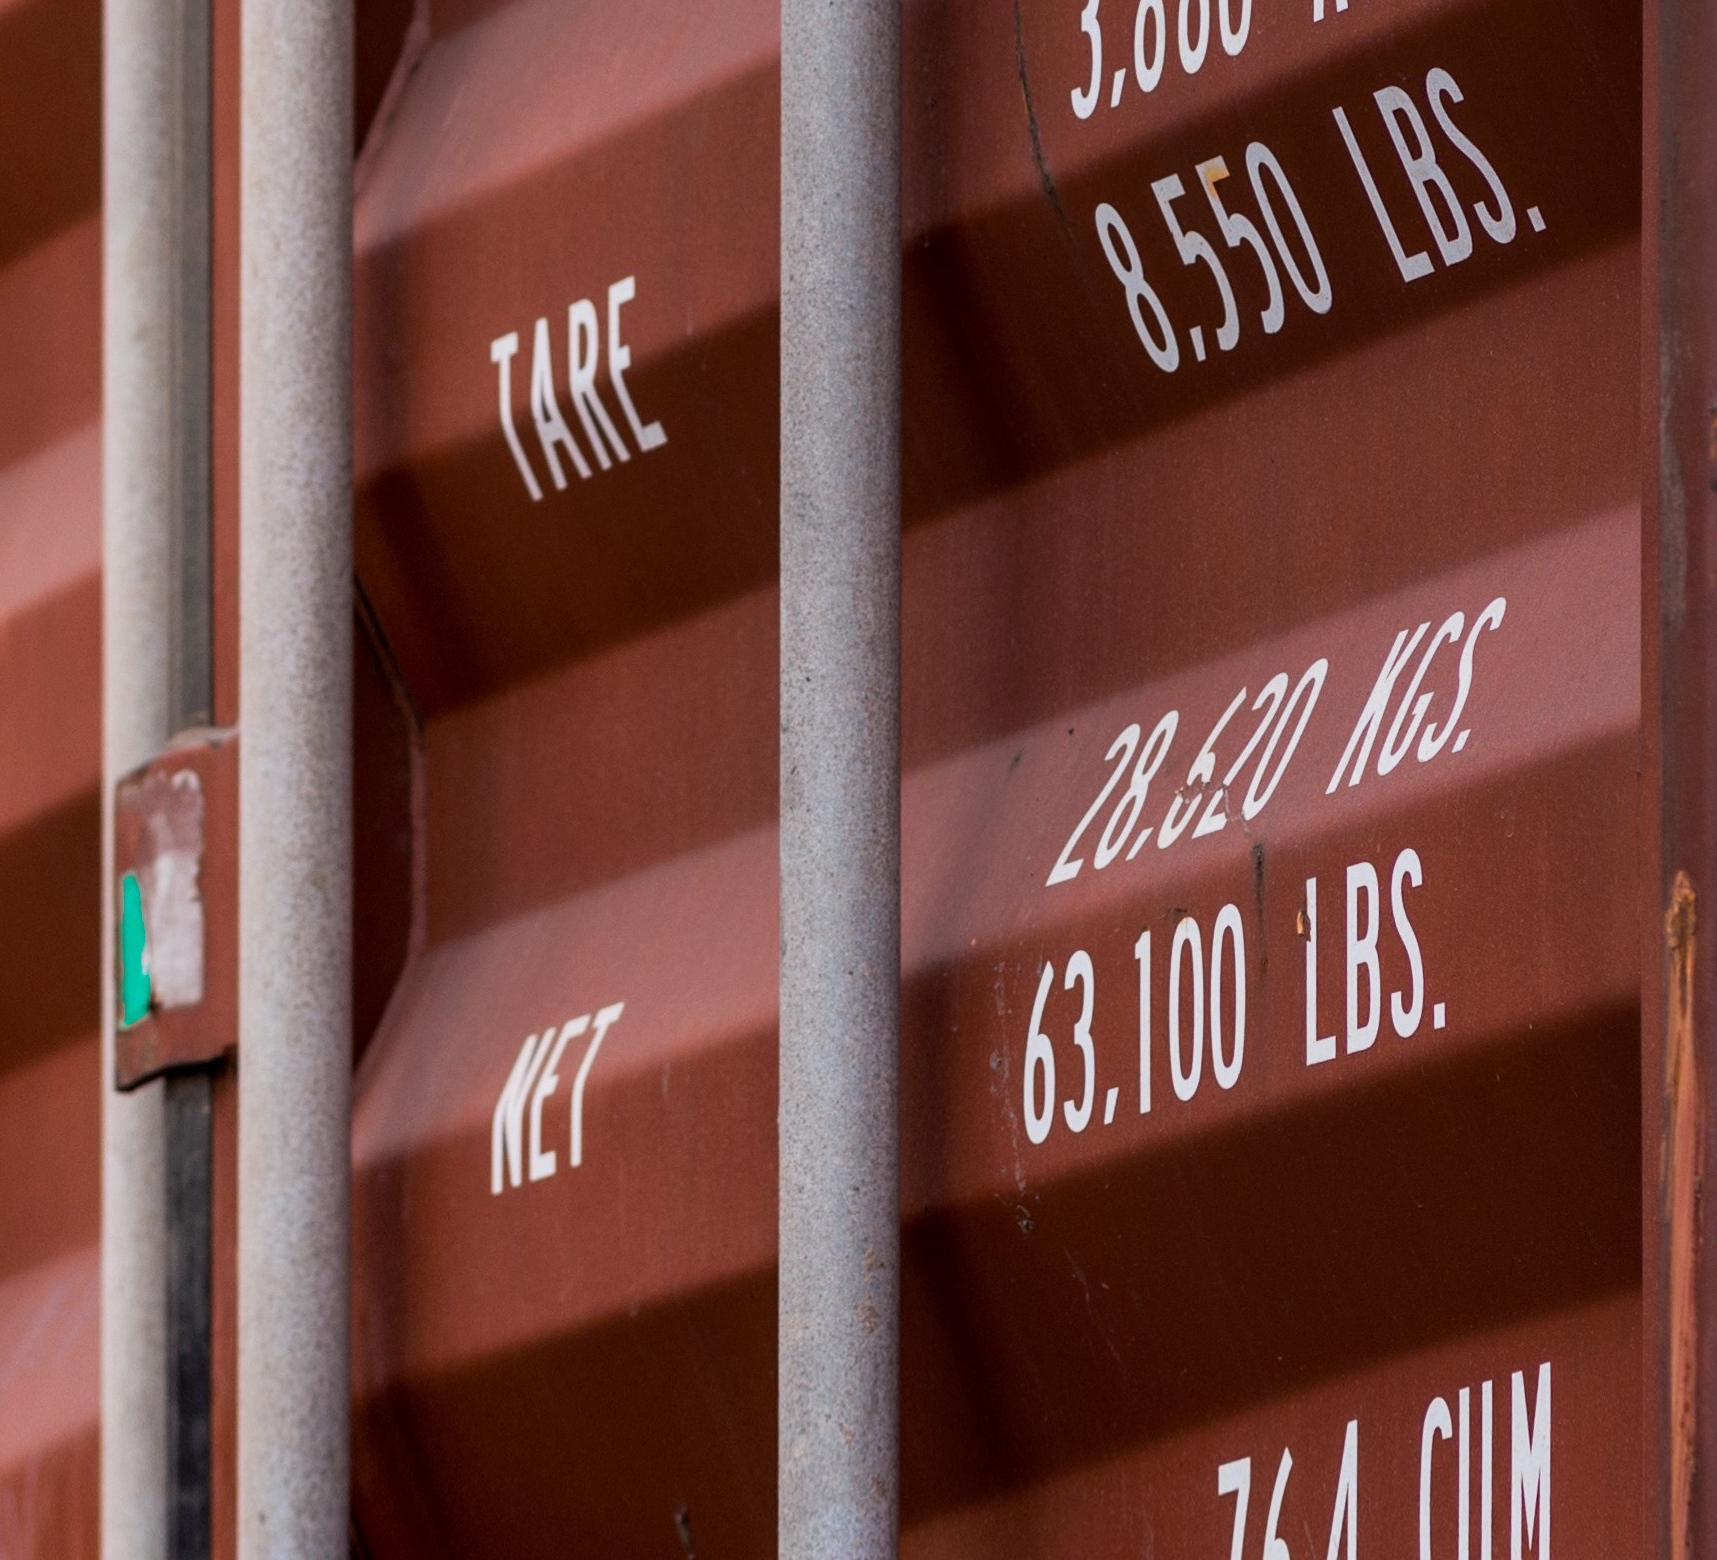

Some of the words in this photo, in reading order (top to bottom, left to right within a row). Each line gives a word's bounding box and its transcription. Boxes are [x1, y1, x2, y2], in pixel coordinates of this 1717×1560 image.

[1094, 141, 1332, 373] 8,550
[1332, 67, 1547, 283] LBS.
[490, 275, 669, 502] TARE
[1045, 657, 1329, 888] 28,620
[1325, 596, 1507, 796] KGS.
[491, 1001, 625, 1196] NET
[1023, 902, 1247, 1145] 63,100
[1305, 847, 1447, 1067] LBS.
